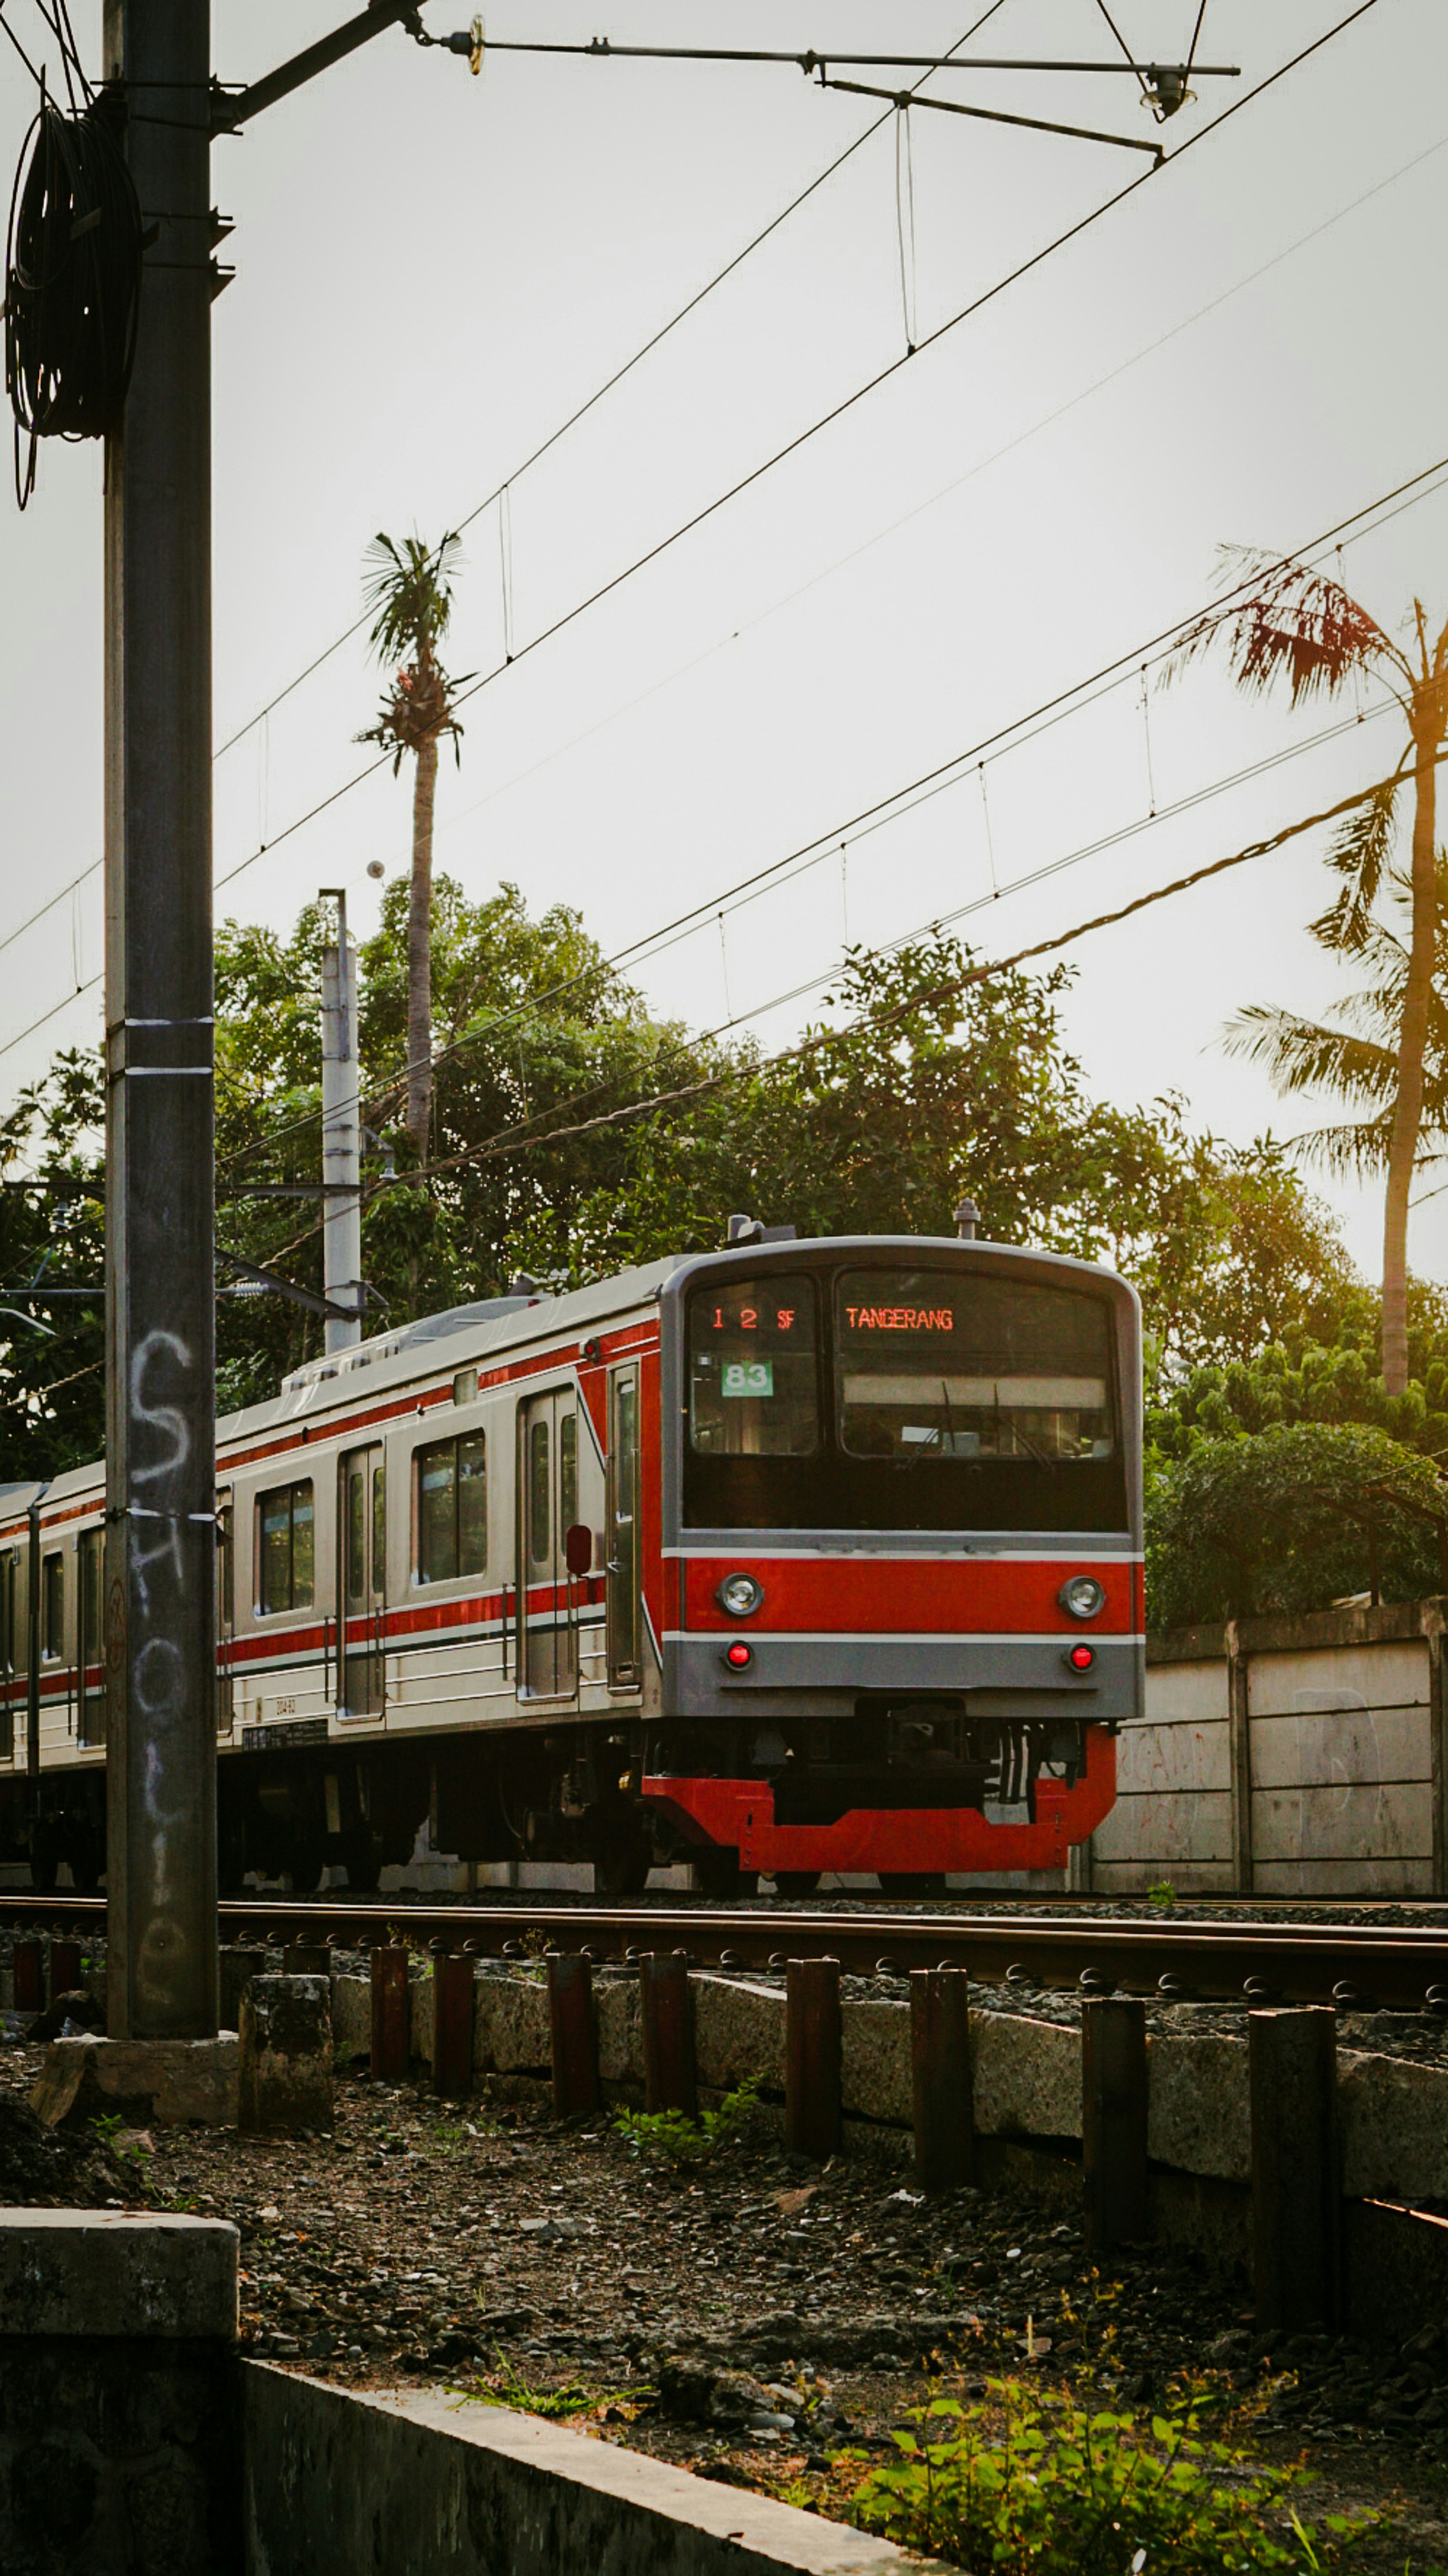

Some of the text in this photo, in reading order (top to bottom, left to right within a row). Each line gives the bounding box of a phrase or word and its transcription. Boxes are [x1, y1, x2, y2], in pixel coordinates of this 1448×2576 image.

[777, 1308, 795, 1330] SF
[845, 1306, 954, 1331] TANGERANG
[725, 1364, 768, 1388] 83
